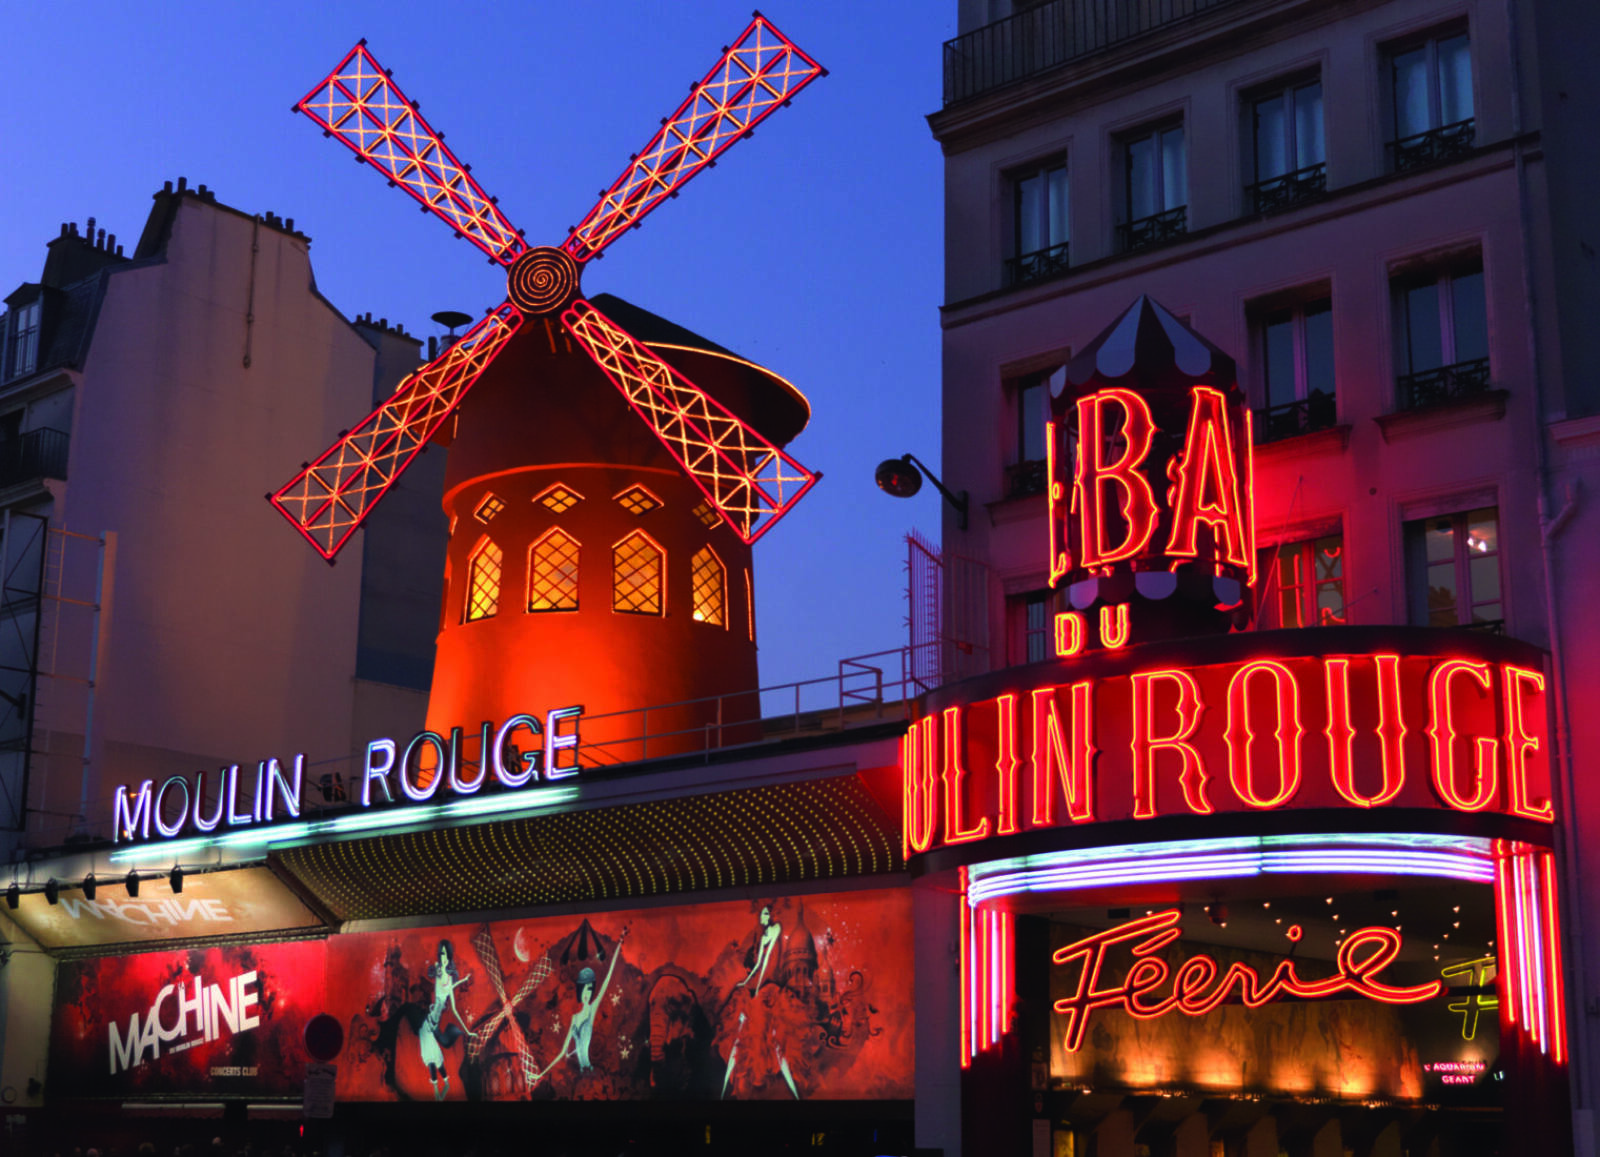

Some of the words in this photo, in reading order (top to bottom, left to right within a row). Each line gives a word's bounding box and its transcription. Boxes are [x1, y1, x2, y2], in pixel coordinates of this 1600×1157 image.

[1077, 385, 1257, 588] BA
[1054, 602, 1131, 657] DU
[113, 753, 307, 842] MOULIN
[362, 705, 584, 807] ROUGE
[902, 678, 1097, 861] ULIN
[1130, 654, 1556, 823] ROUGE
[108, 970, 260, 1075] MACHINE
[1052, 908, 1442, 1052] Féerie
